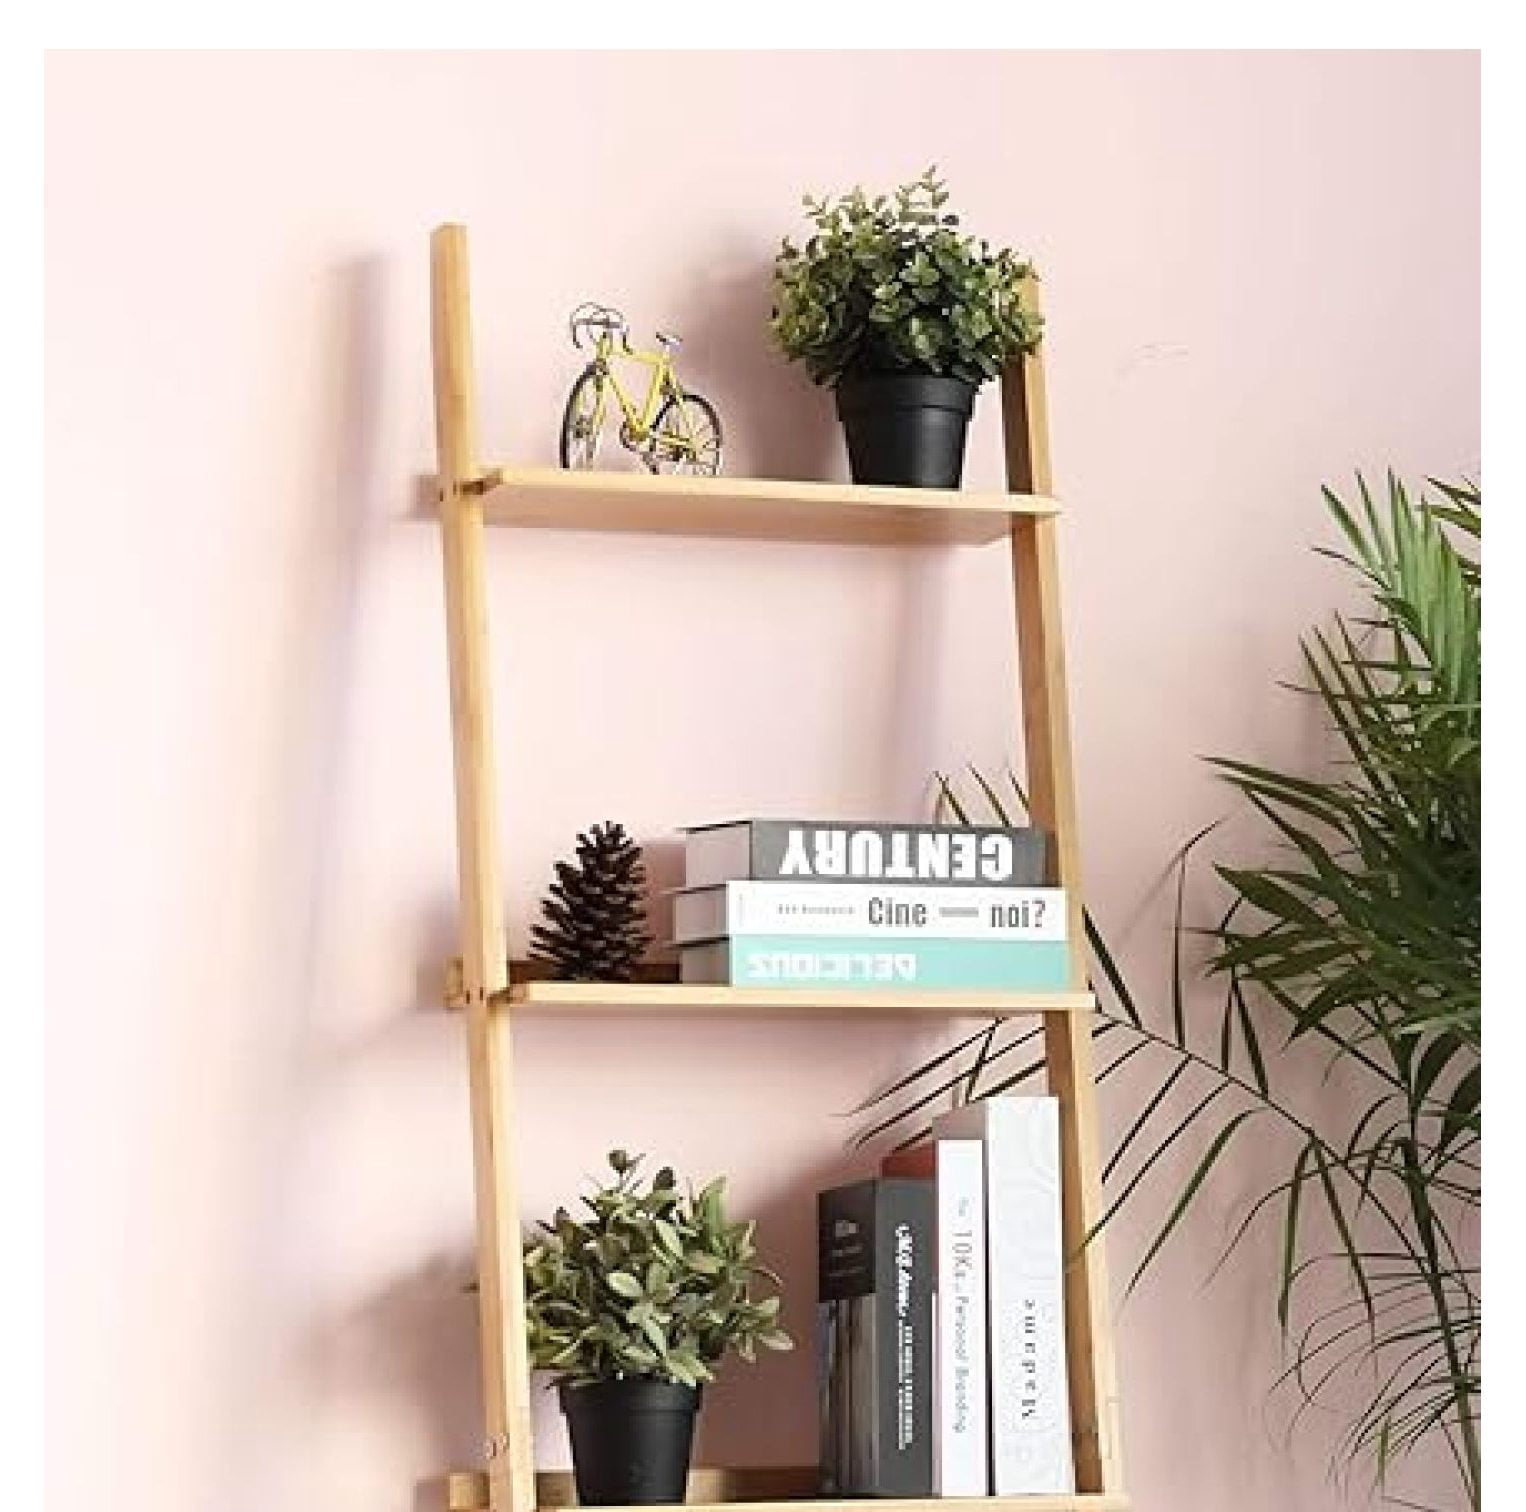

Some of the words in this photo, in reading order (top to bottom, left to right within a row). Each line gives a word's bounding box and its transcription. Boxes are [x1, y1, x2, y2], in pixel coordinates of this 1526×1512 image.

[779, 829, 1013, 881] CENTURY
[990, 899, 1047, 928] noi?
[745, 951, 917, 981] DELICIOUS
